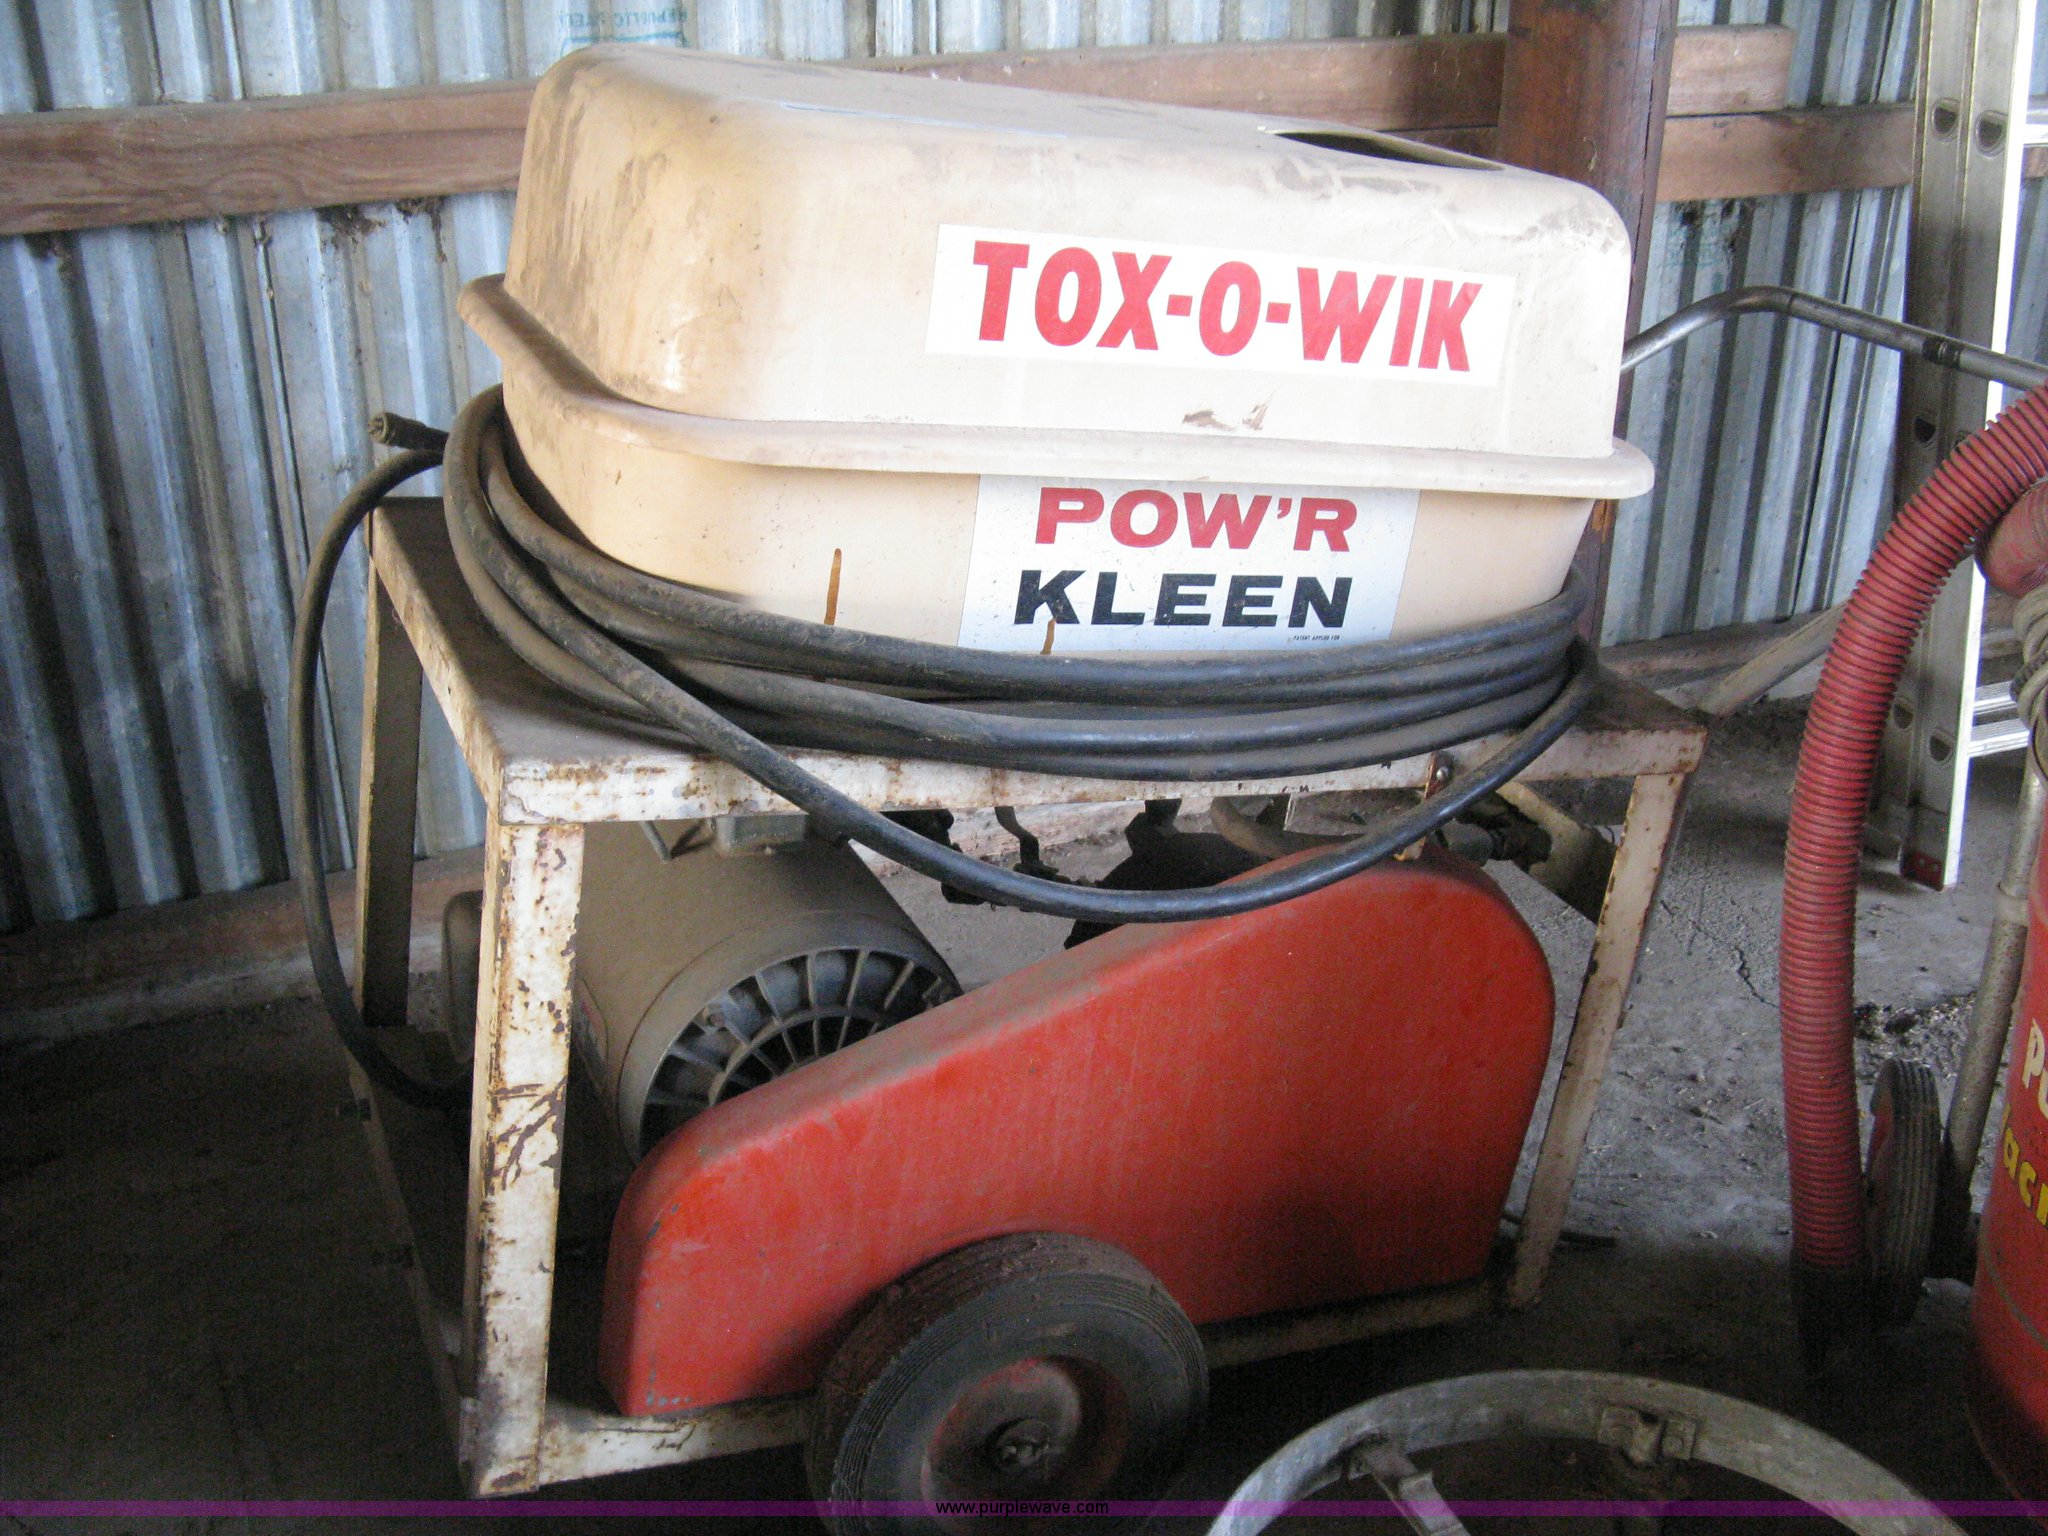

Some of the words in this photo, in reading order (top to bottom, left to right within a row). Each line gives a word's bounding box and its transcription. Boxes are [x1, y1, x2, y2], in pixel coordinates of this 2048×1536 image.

[973, 240, 1483, 372] TOX-O-WIK
[1036, 487, 1357, 552] POW'R
[1014, 569, 1353, 628] KLEEN
